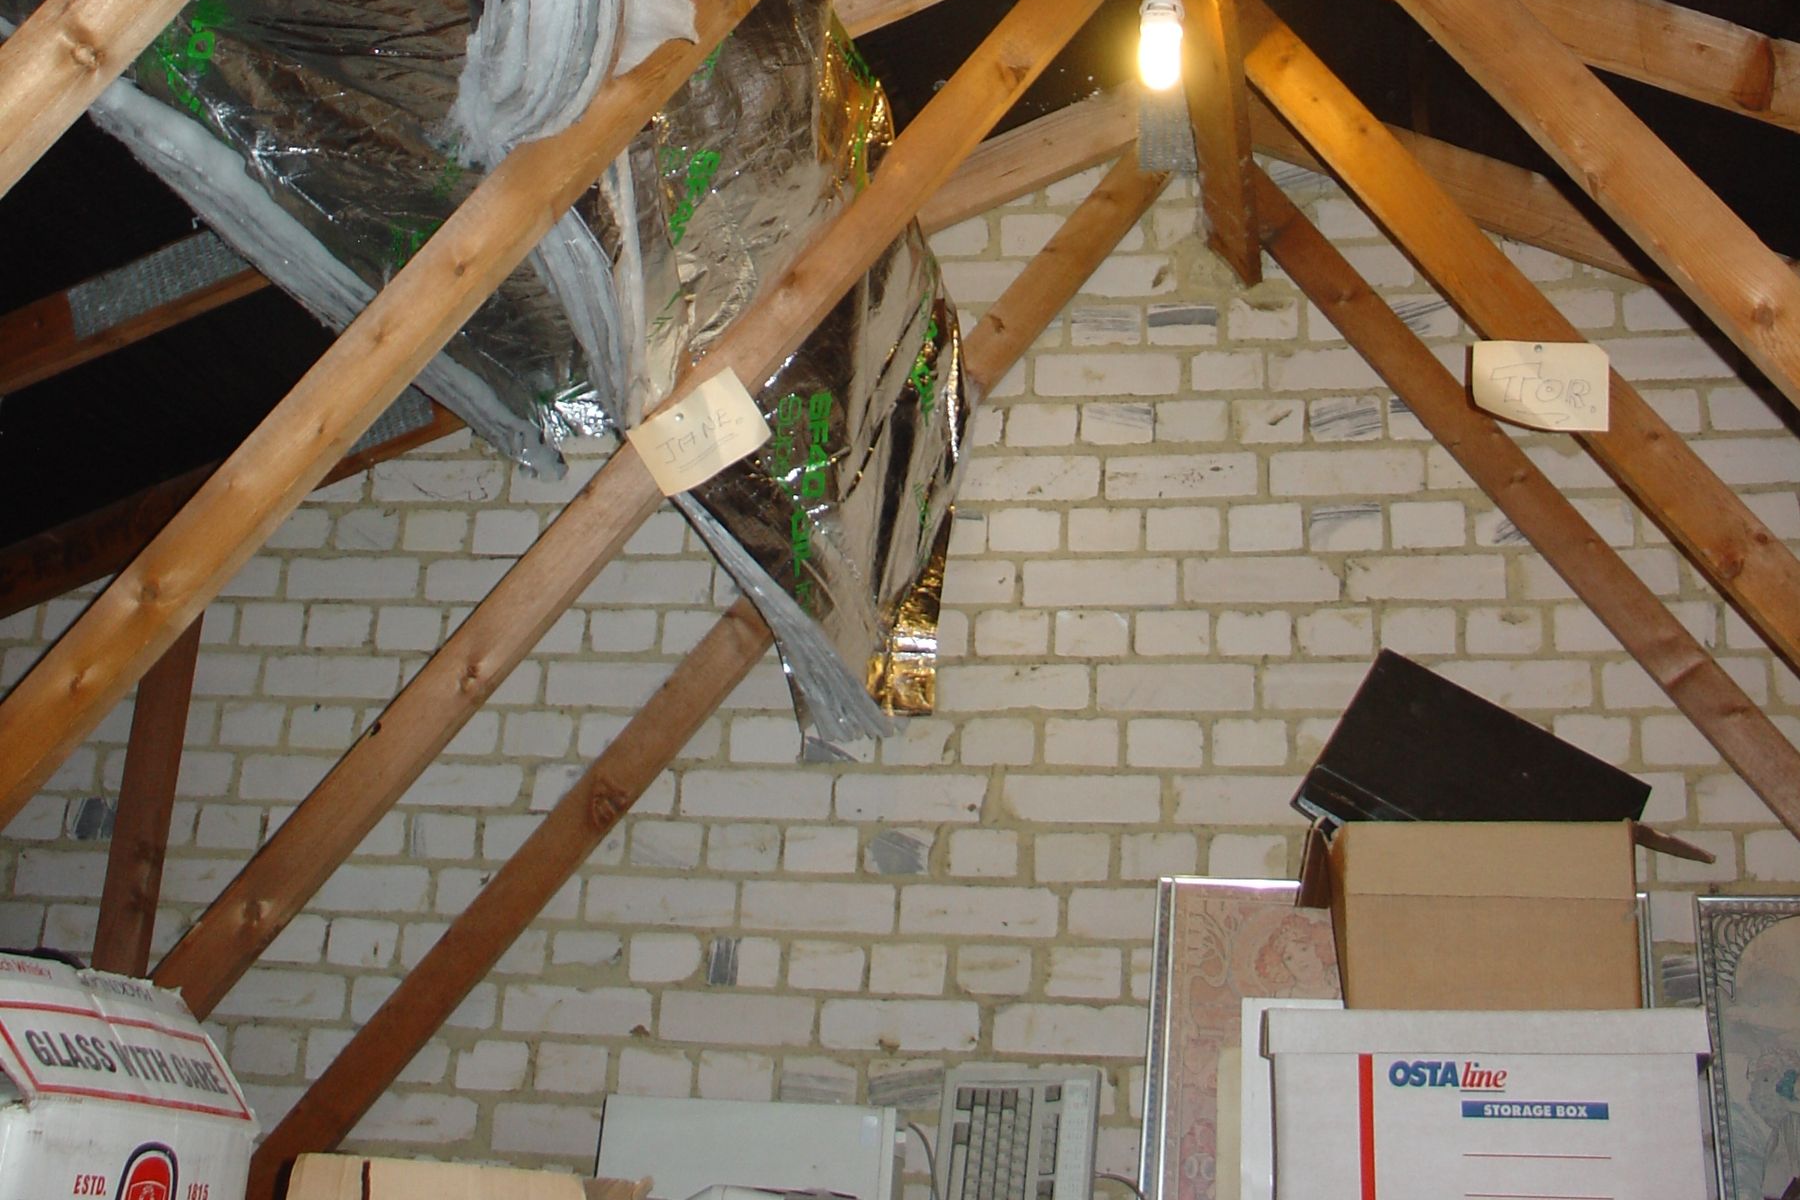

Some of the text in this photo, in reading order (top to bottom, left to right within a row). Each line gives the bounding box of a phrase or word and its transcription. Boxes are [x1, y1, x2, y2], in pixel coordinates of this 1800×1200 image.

[25, 1029, 229, 1095] GLASS WITH CARE
[1483, 1103, 1589, 1118] STORAGE BOX
[73, 1174, 107, 1196] ESTD.
[187, 1183, 210, 1200] 1815
